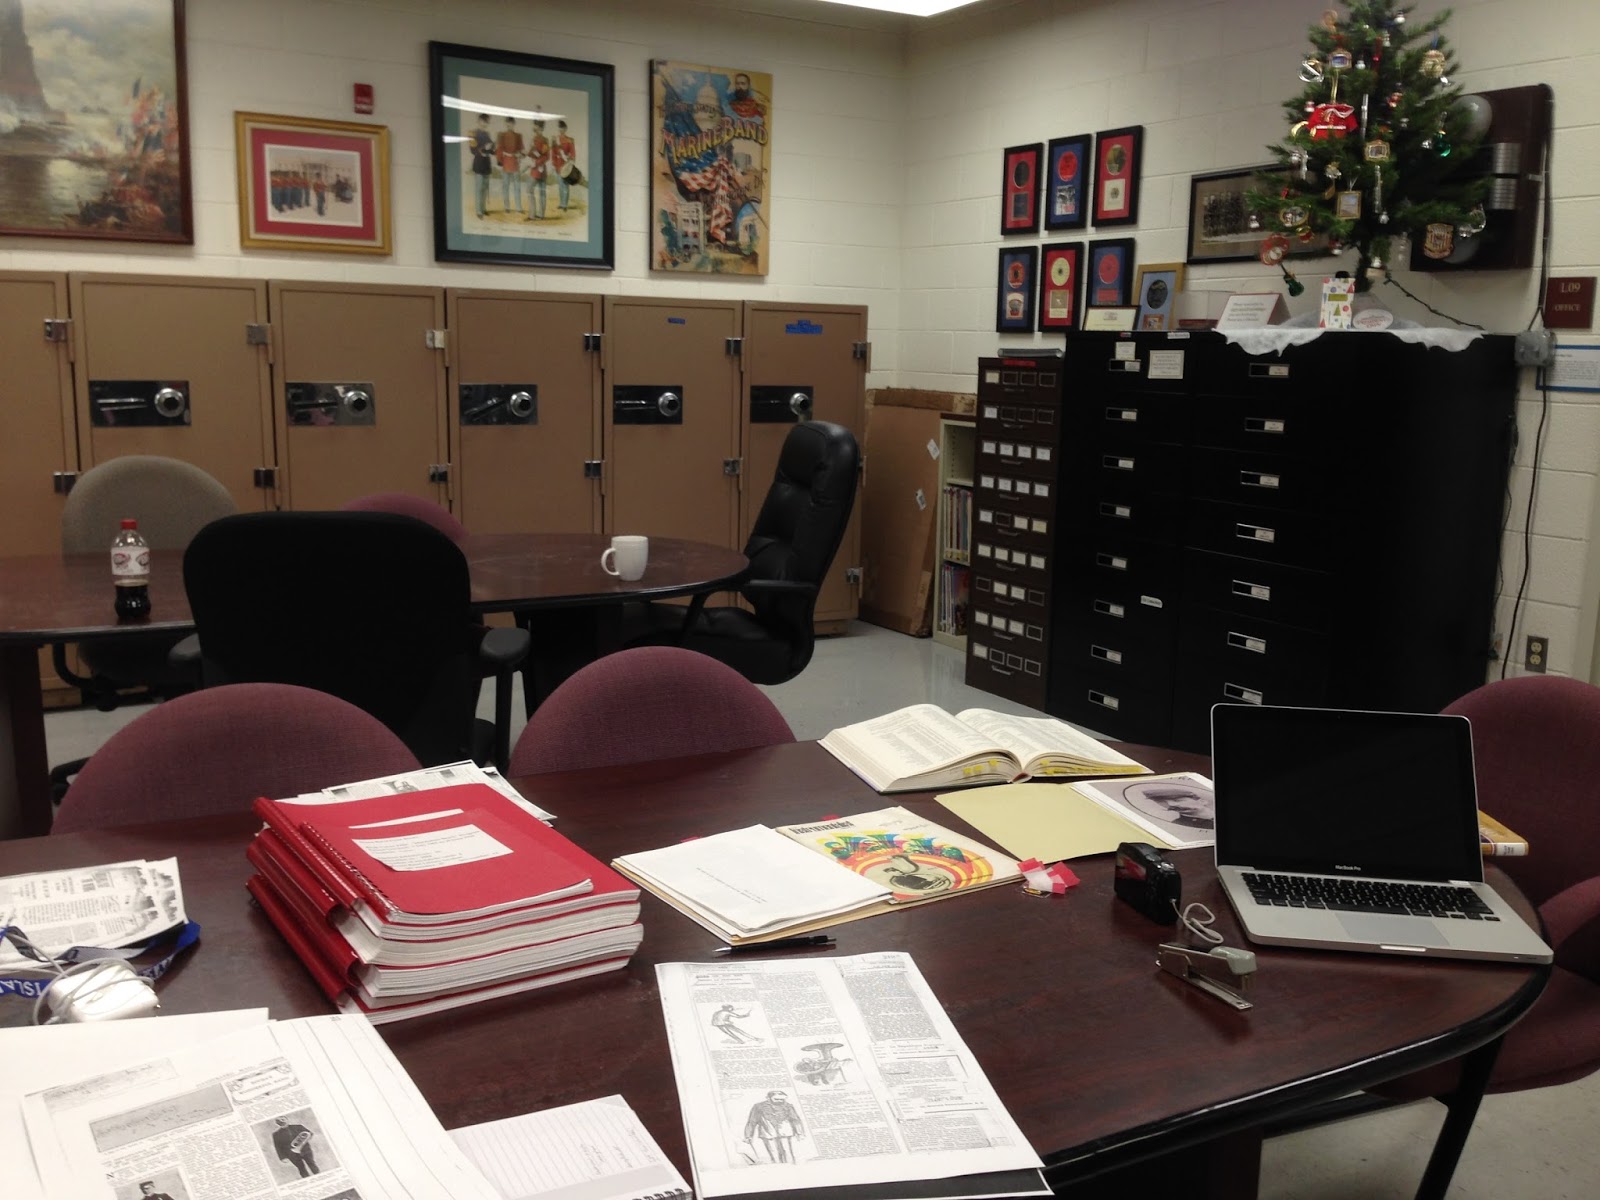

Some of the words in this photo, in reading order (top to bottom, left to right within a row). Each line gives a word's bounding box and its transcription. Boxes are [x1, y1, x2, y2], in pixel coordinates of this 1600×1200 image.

[660, 126, 721, 164] MARINE
[720, 116, 769, 146] BAND
[1560, 282, 1581, 294] L09
[1554, 303, 1581, 312] OFFICE
